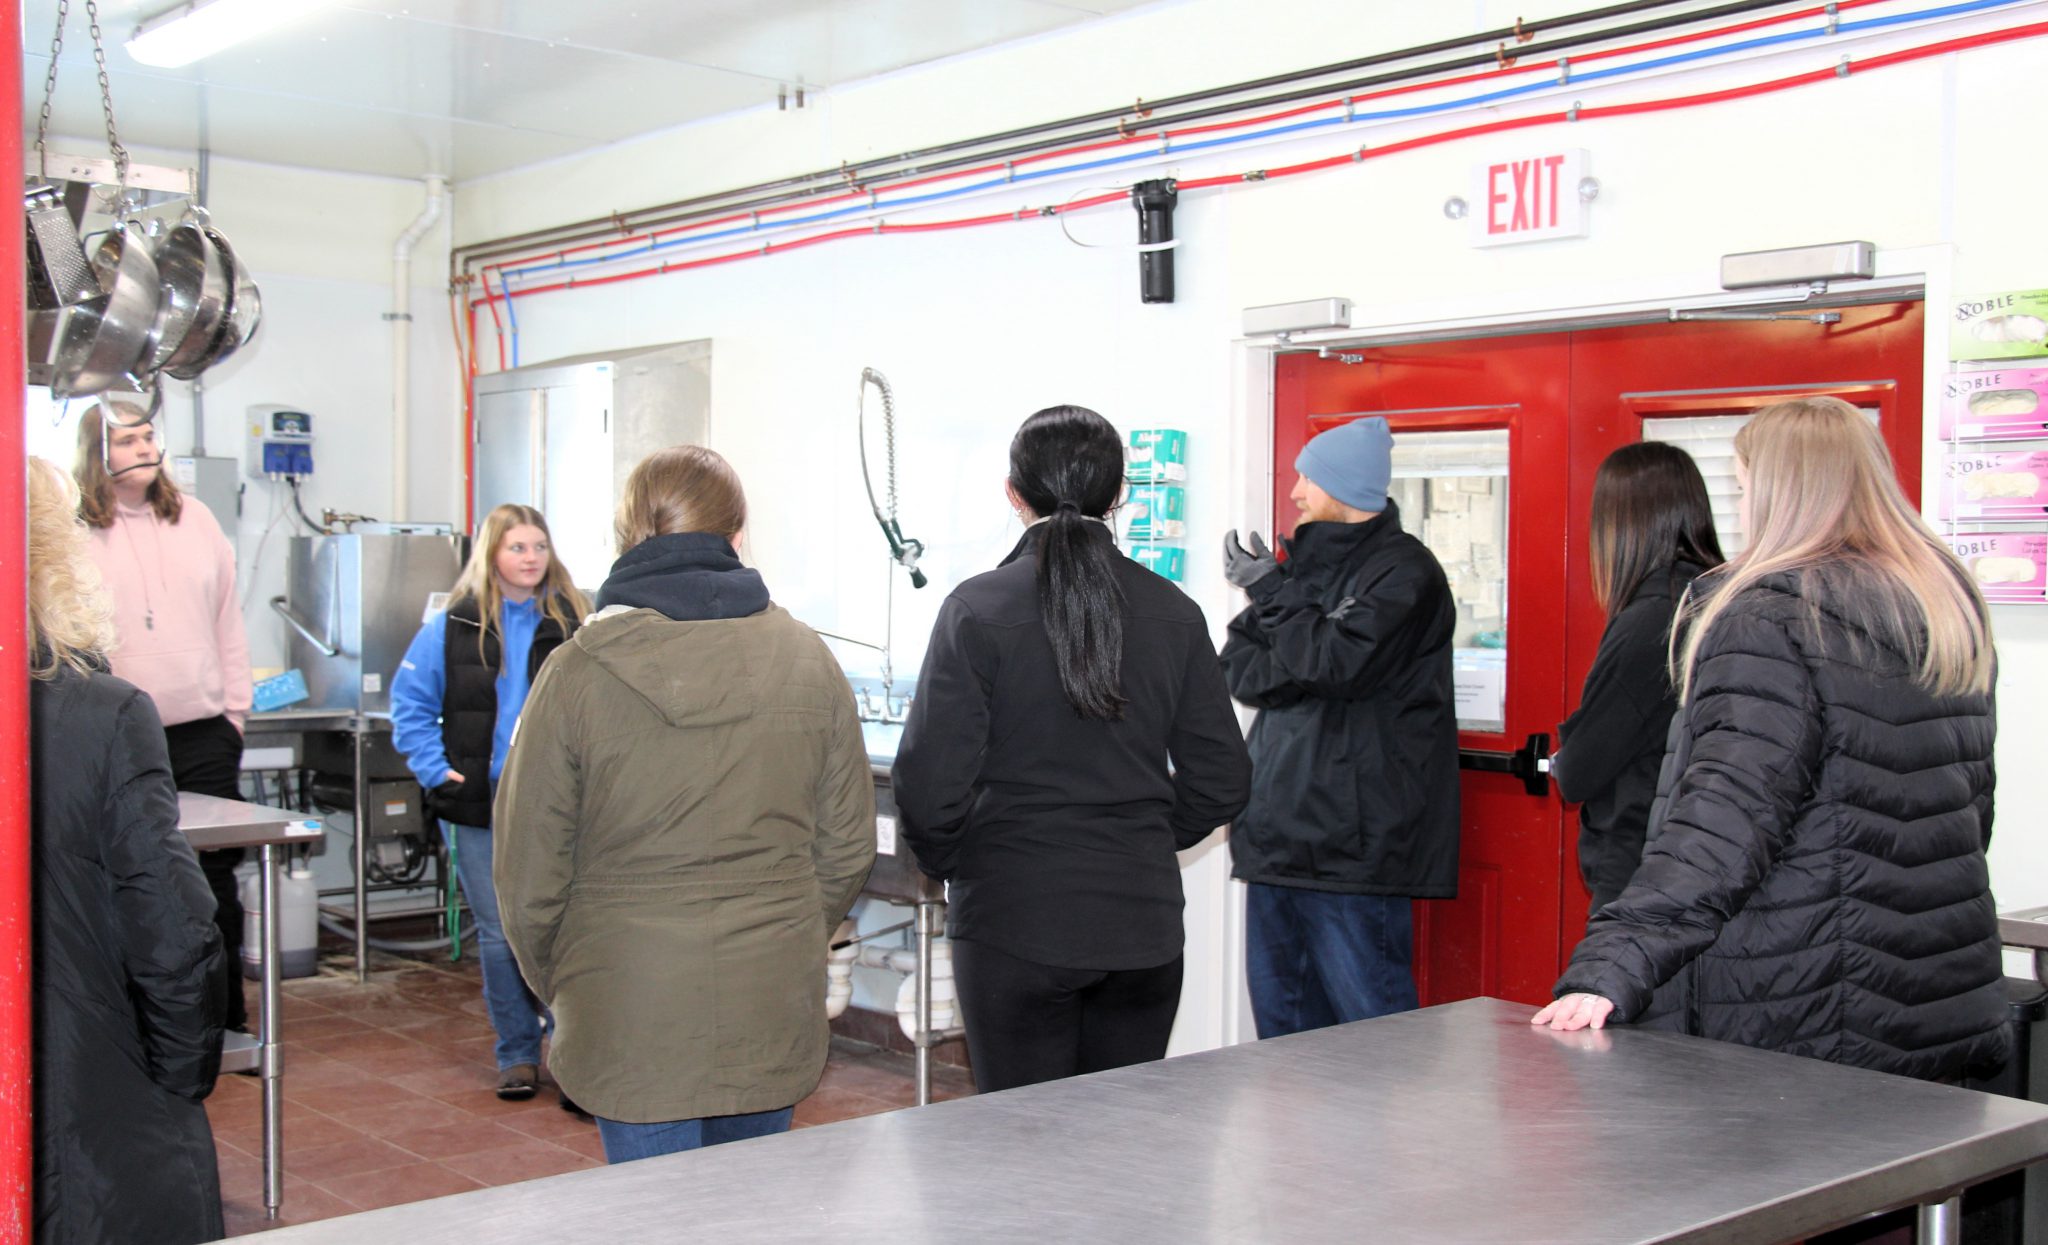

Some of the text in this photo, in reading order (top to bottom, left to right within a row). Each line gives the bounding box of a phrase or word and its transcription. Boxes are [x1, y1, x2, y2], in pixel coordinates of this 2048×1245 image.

[1488, 155, 1565, 234] EXIT
[1956, 294, 2014, 321] NOBLE
[1950, 539, 1997, 557] OBLE
